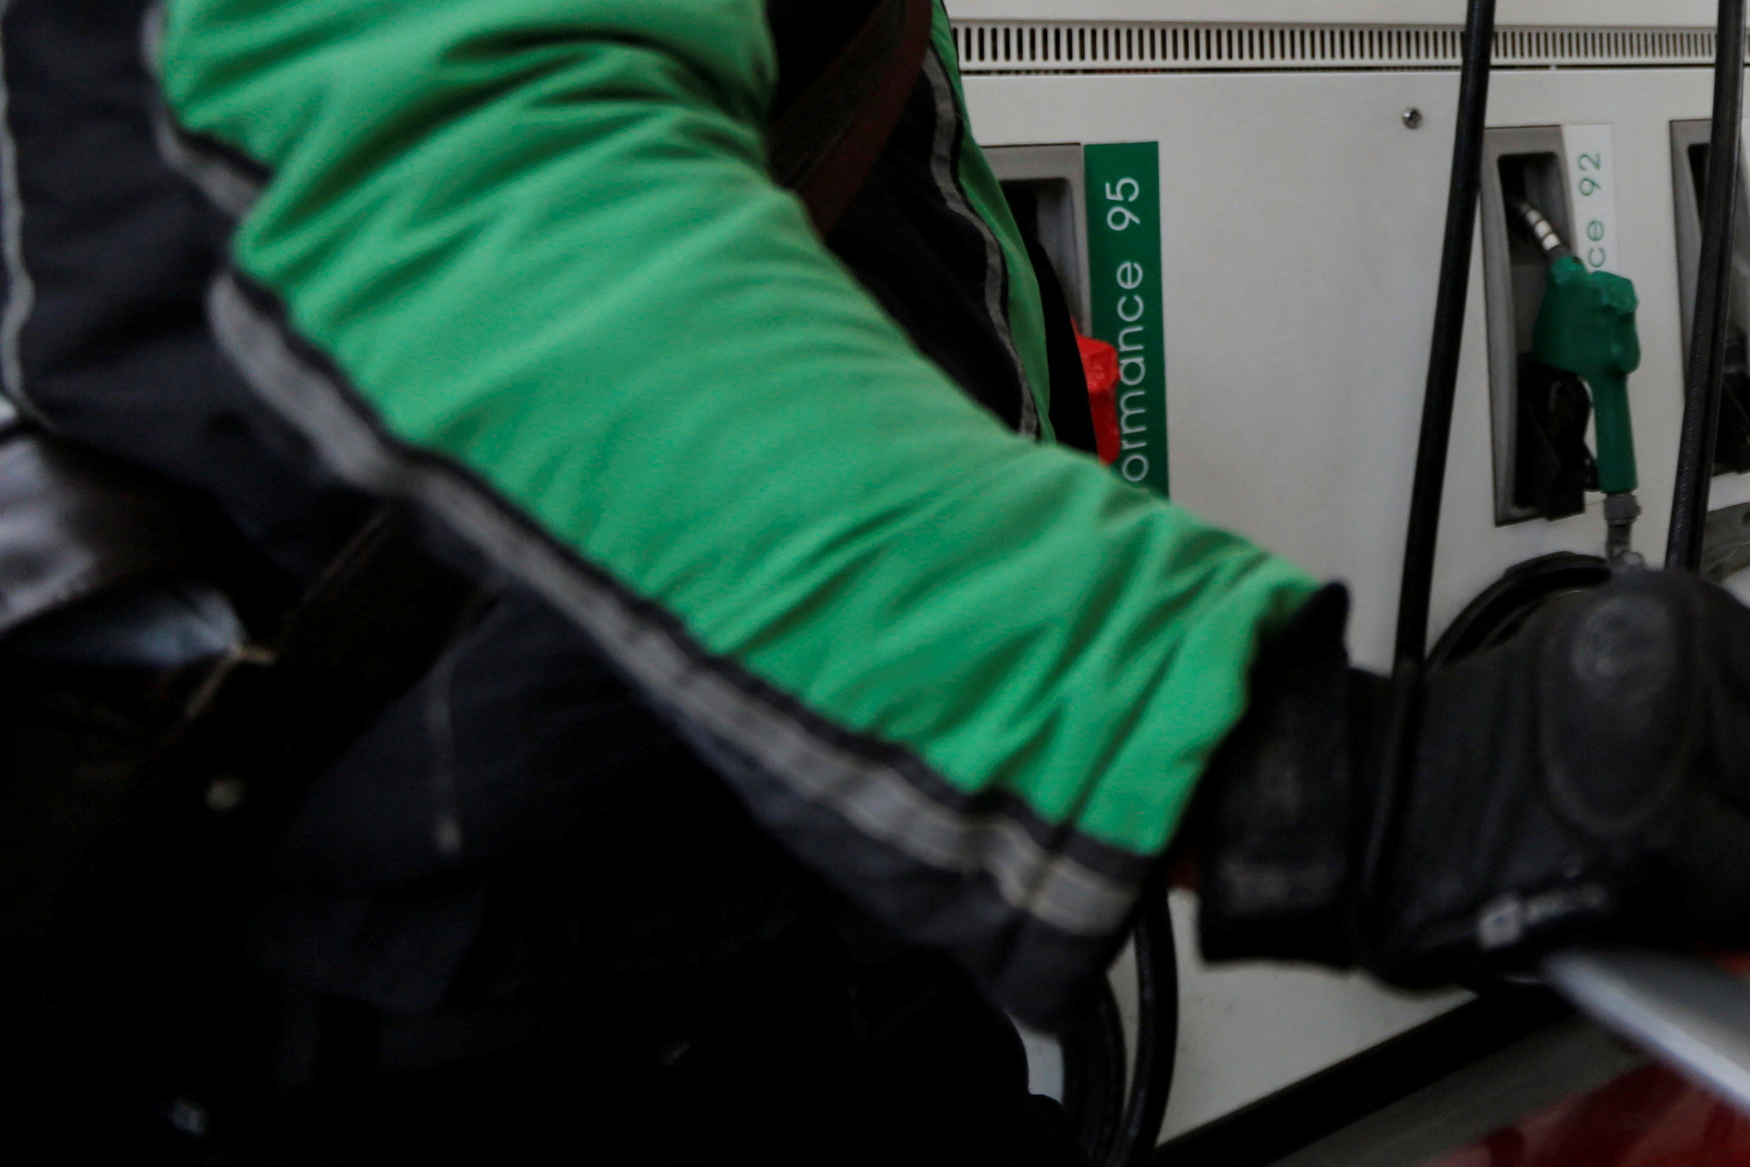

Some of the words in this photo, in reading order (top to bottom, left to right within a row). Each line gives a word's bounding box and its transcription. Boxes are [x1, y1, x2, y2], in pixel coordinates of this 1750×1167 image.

[1578, 152, 1601, 197] 92
[1105, 176, 1141, 232] 95
[1116, 261, 1149, 482] ormance
